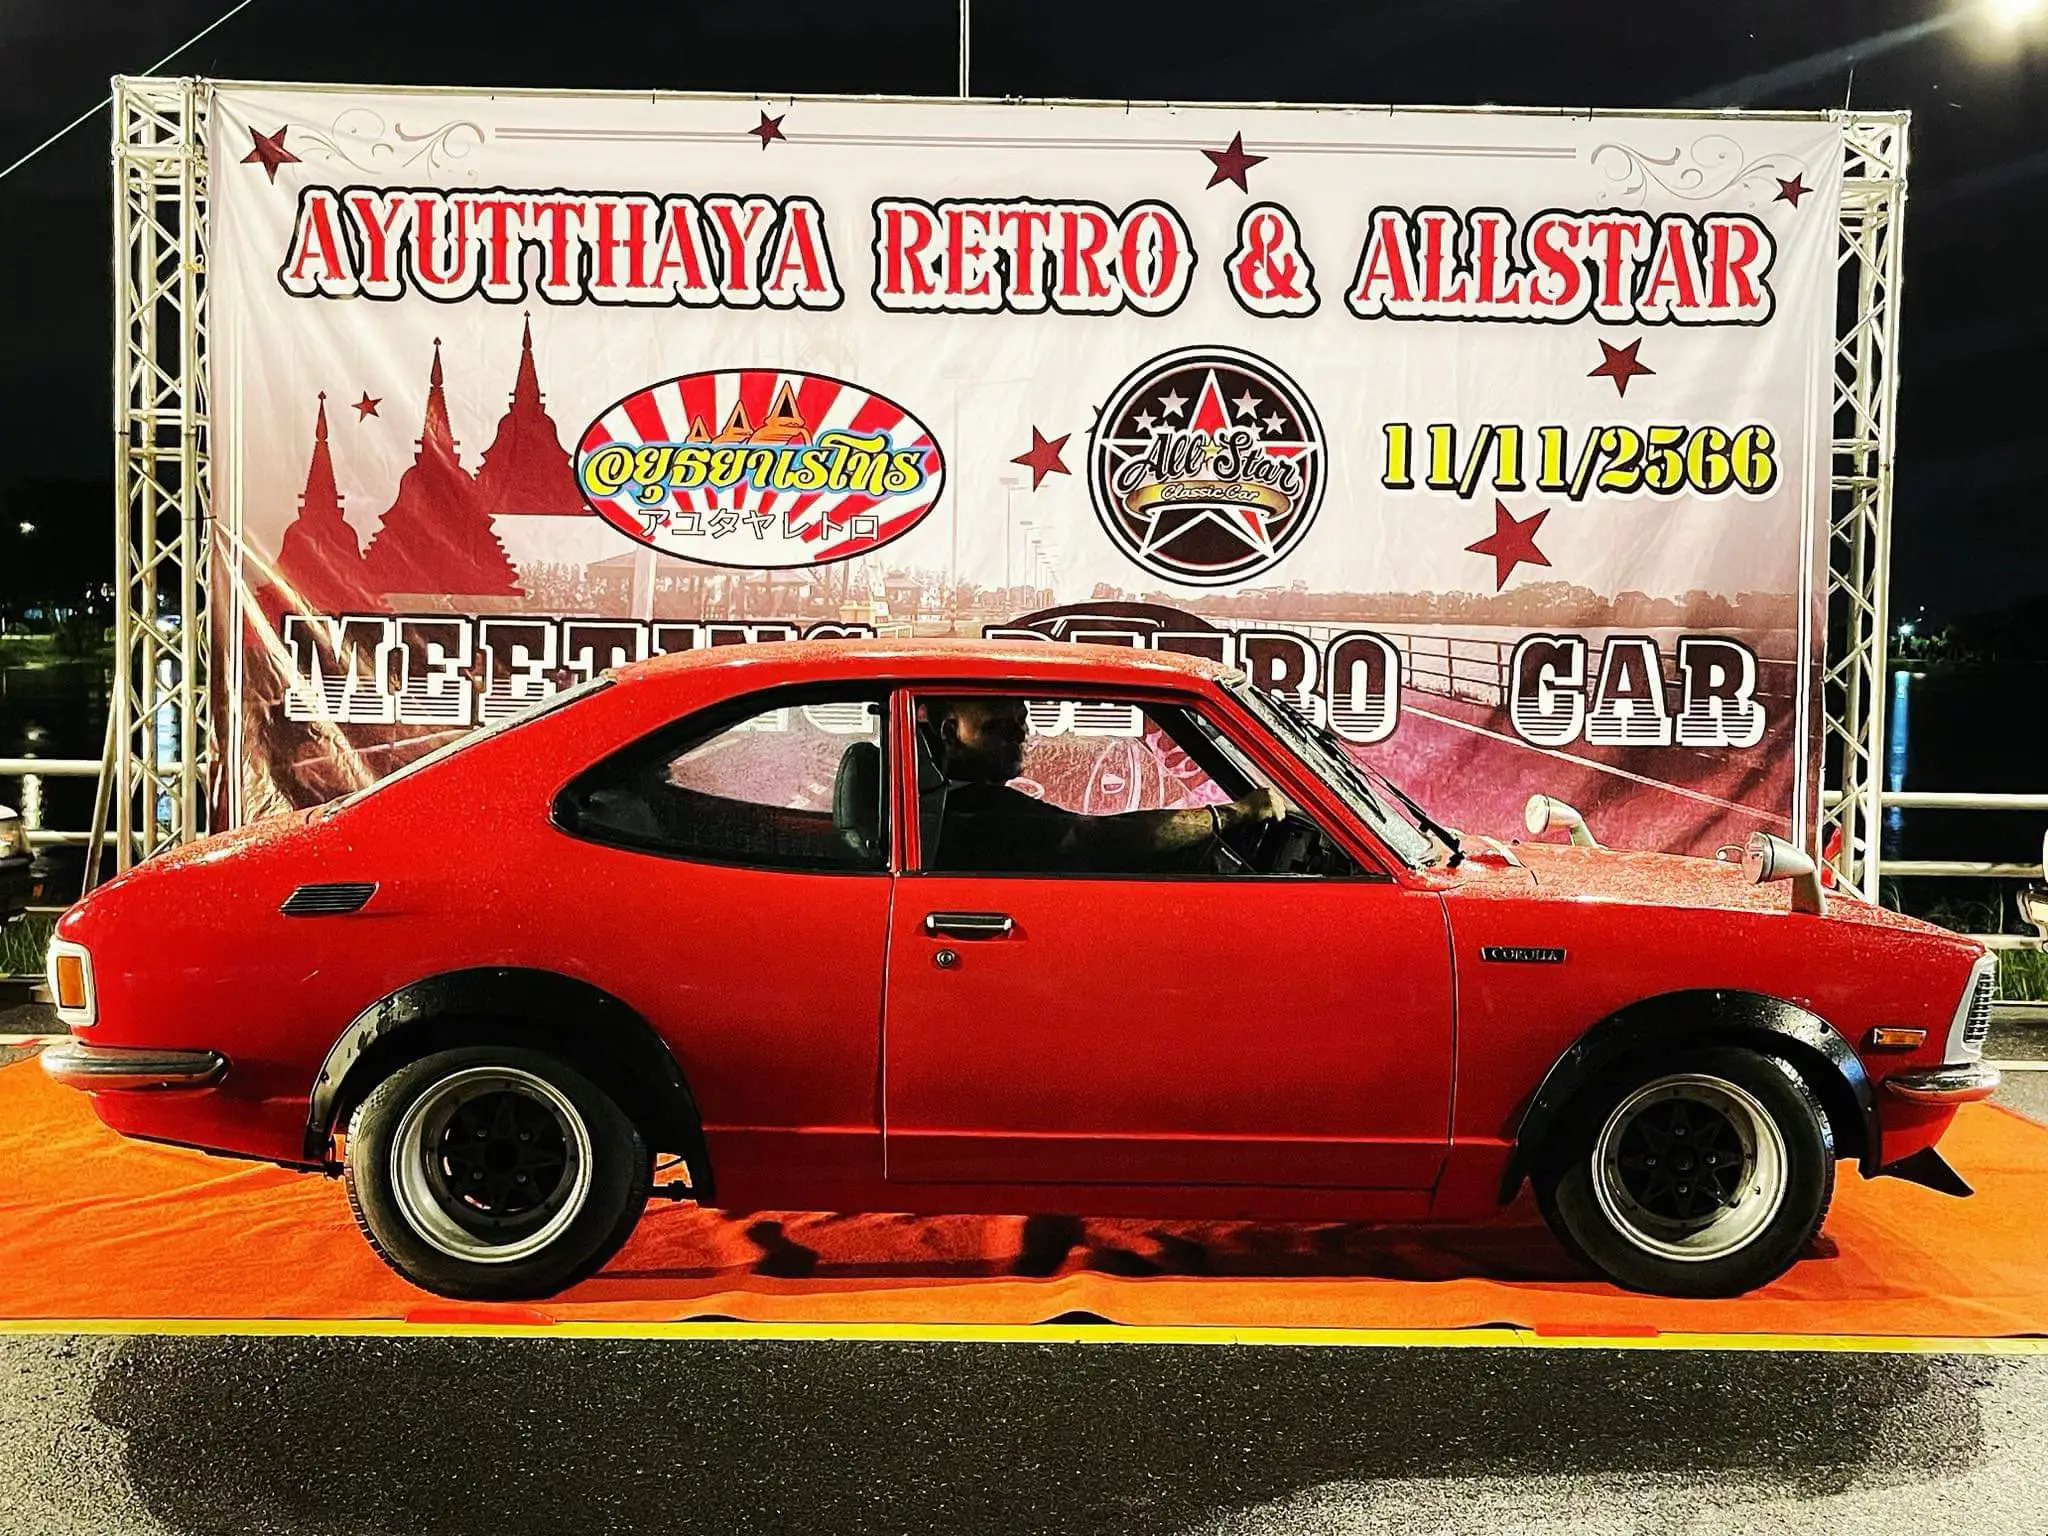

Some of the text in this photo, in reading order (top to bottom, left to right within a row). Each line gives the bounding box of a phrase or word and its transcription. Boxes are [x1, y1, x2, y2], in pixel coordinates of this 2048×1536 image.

[280, 186, 1777, 326] AYUTTHAYA RETRO & ALLSTAR
[1117, 430, 1299, 494] All Star
[1161, 482, 1260, 501] Classic Car
[1382, 423, 1777, 500] 11/11/2566
[638, 508, 880, 541] アユタヤレトロ
[283, 614, 877, 735] MEET
[1510, 635, 1766, 748] CAR
